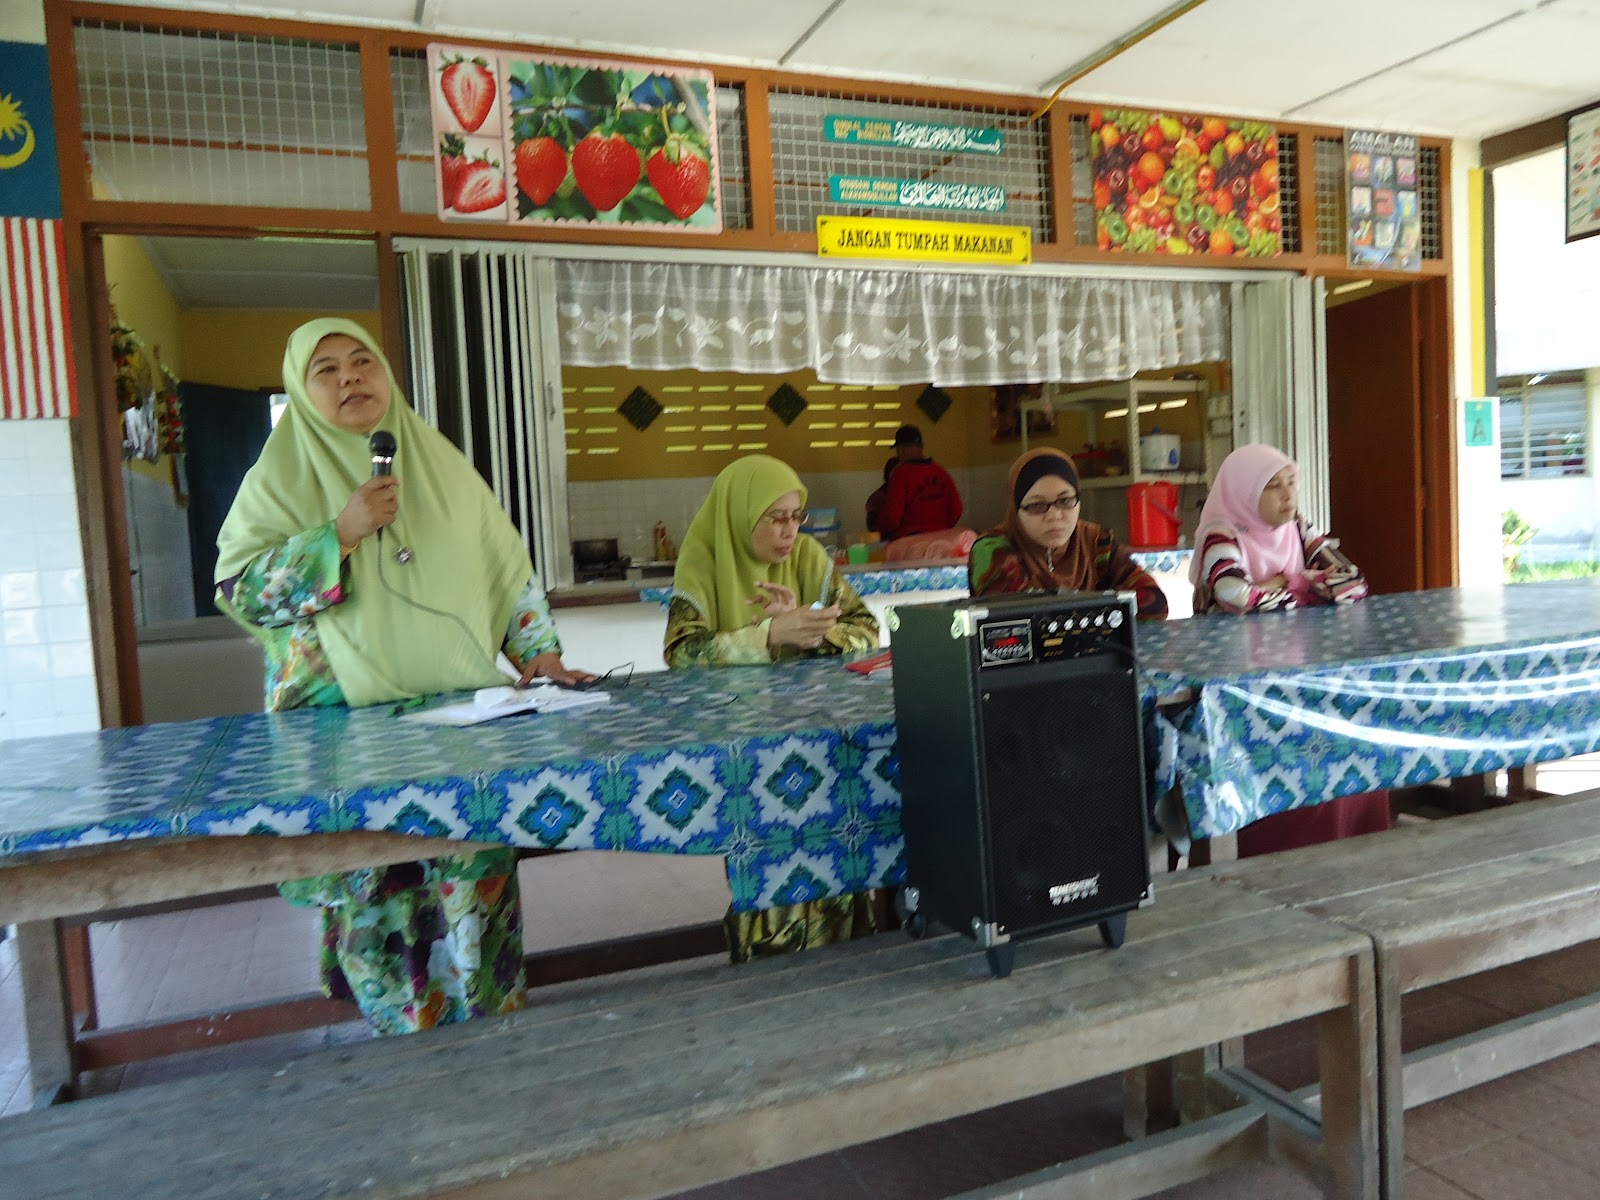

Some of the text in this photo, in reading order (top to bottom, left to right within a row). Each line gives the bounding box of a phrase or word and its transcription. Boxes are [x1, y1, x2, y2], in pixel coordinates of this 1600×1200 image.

[838, 228, 1013, 254] JANGAN TUMPAH MAKANAN
